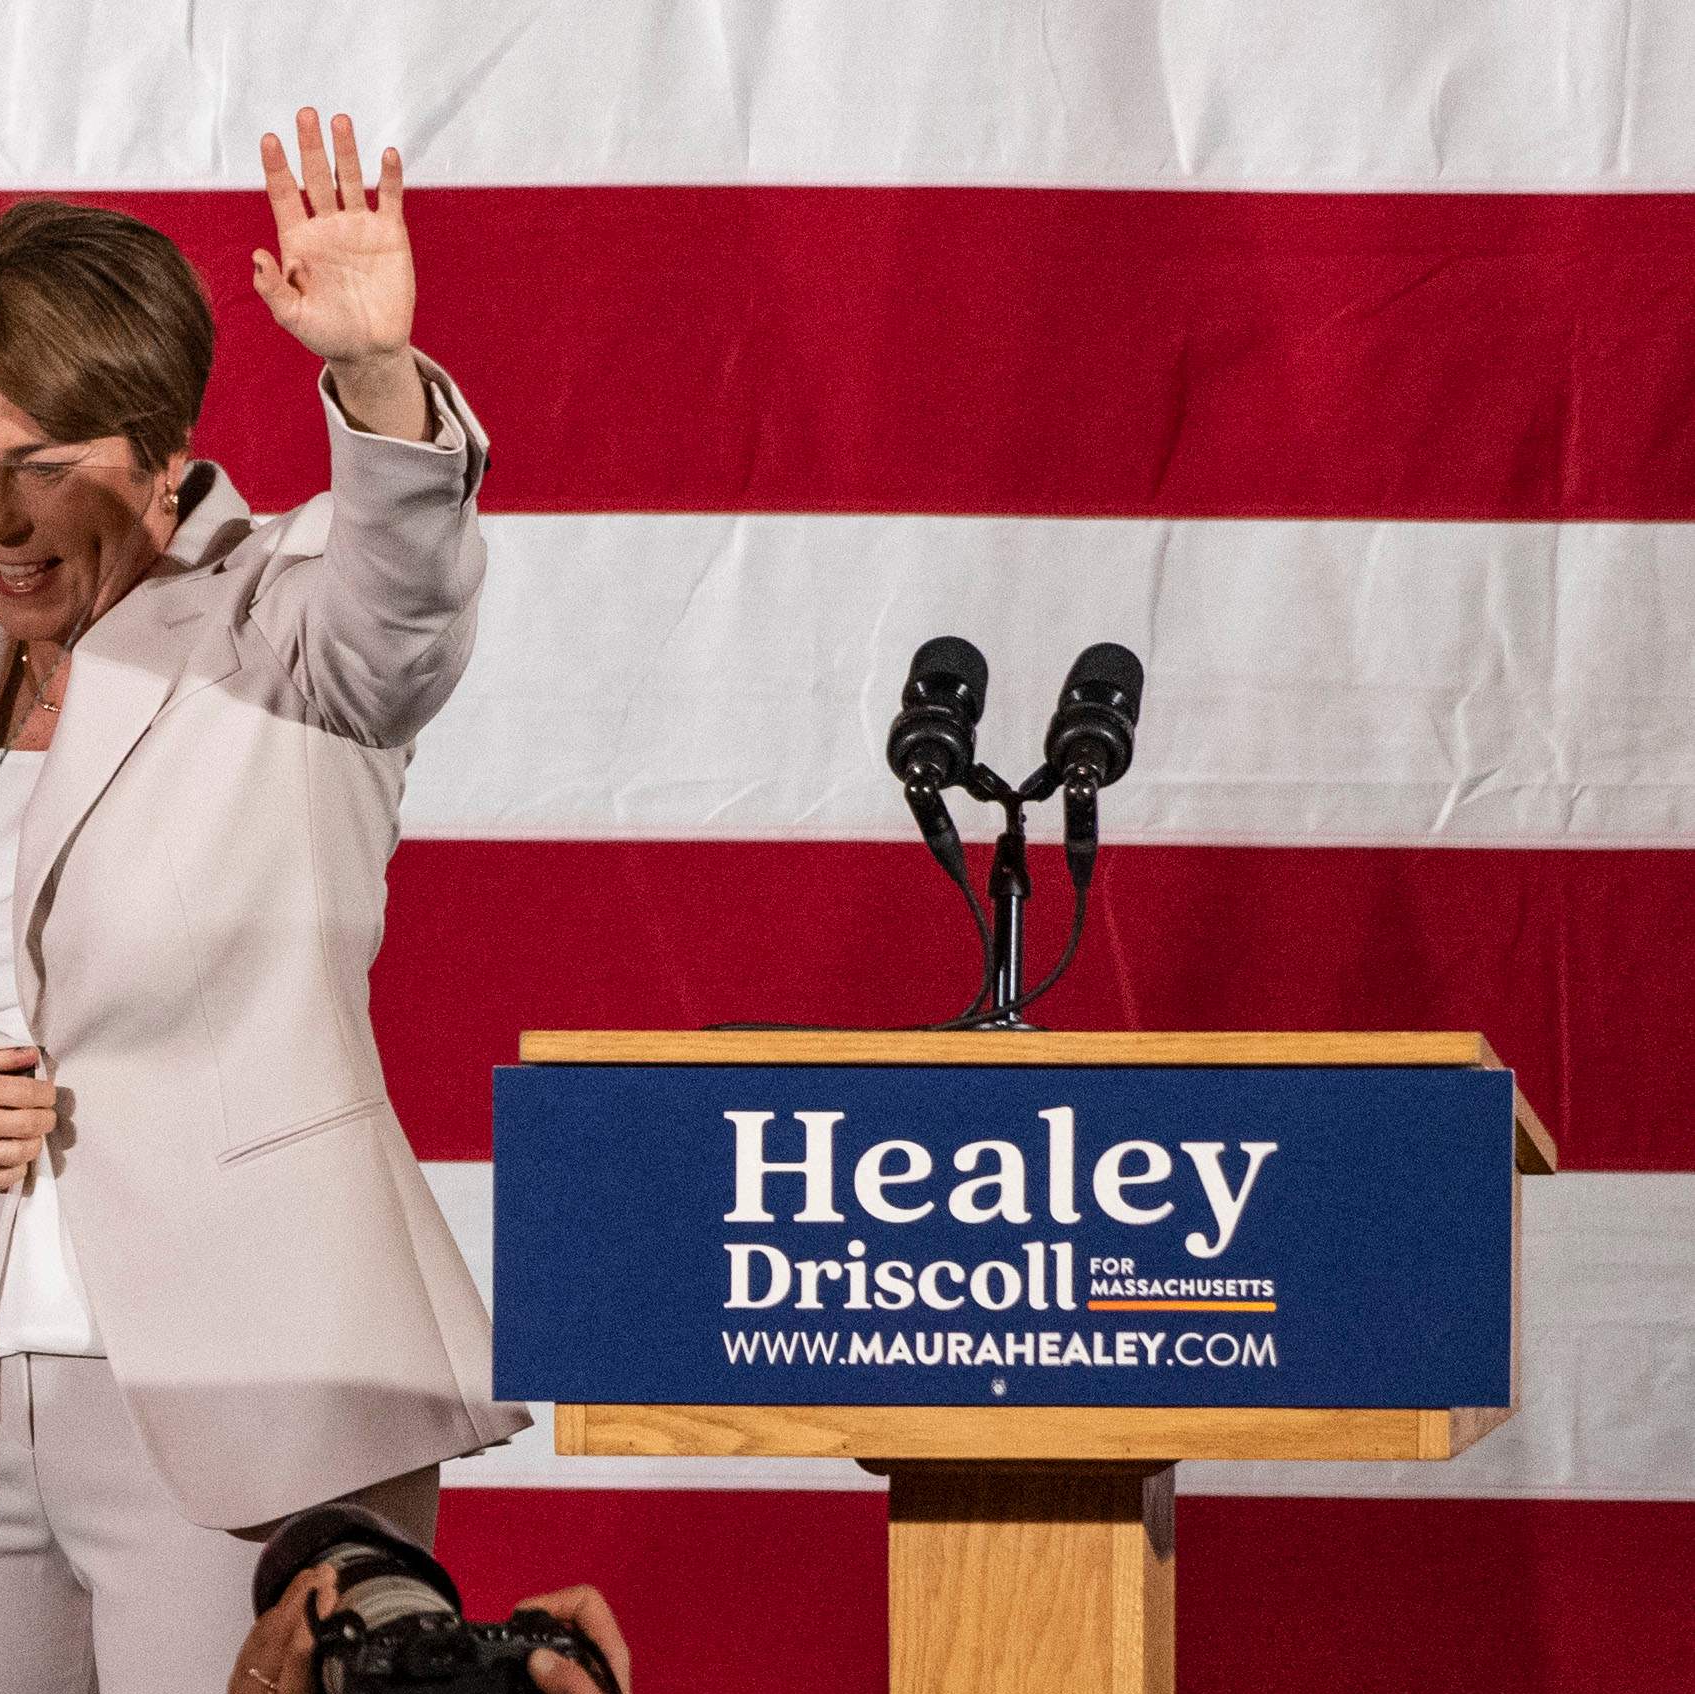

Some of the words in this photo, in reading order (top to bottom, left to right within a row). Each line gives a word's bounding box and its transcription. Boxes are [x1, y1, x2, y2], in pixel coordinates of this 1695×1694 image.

[723, 1106, 1277, 1259] Healey
[723, 1240, 1077, 1311] Driscoll
[1089, 1257, 1135, 1276] FOR
[1090, 1278, 1275, 1297] MASSACHUSETTS
[722, 1331, 1277, 1368] WWW.MAURAHEALEY.COM
